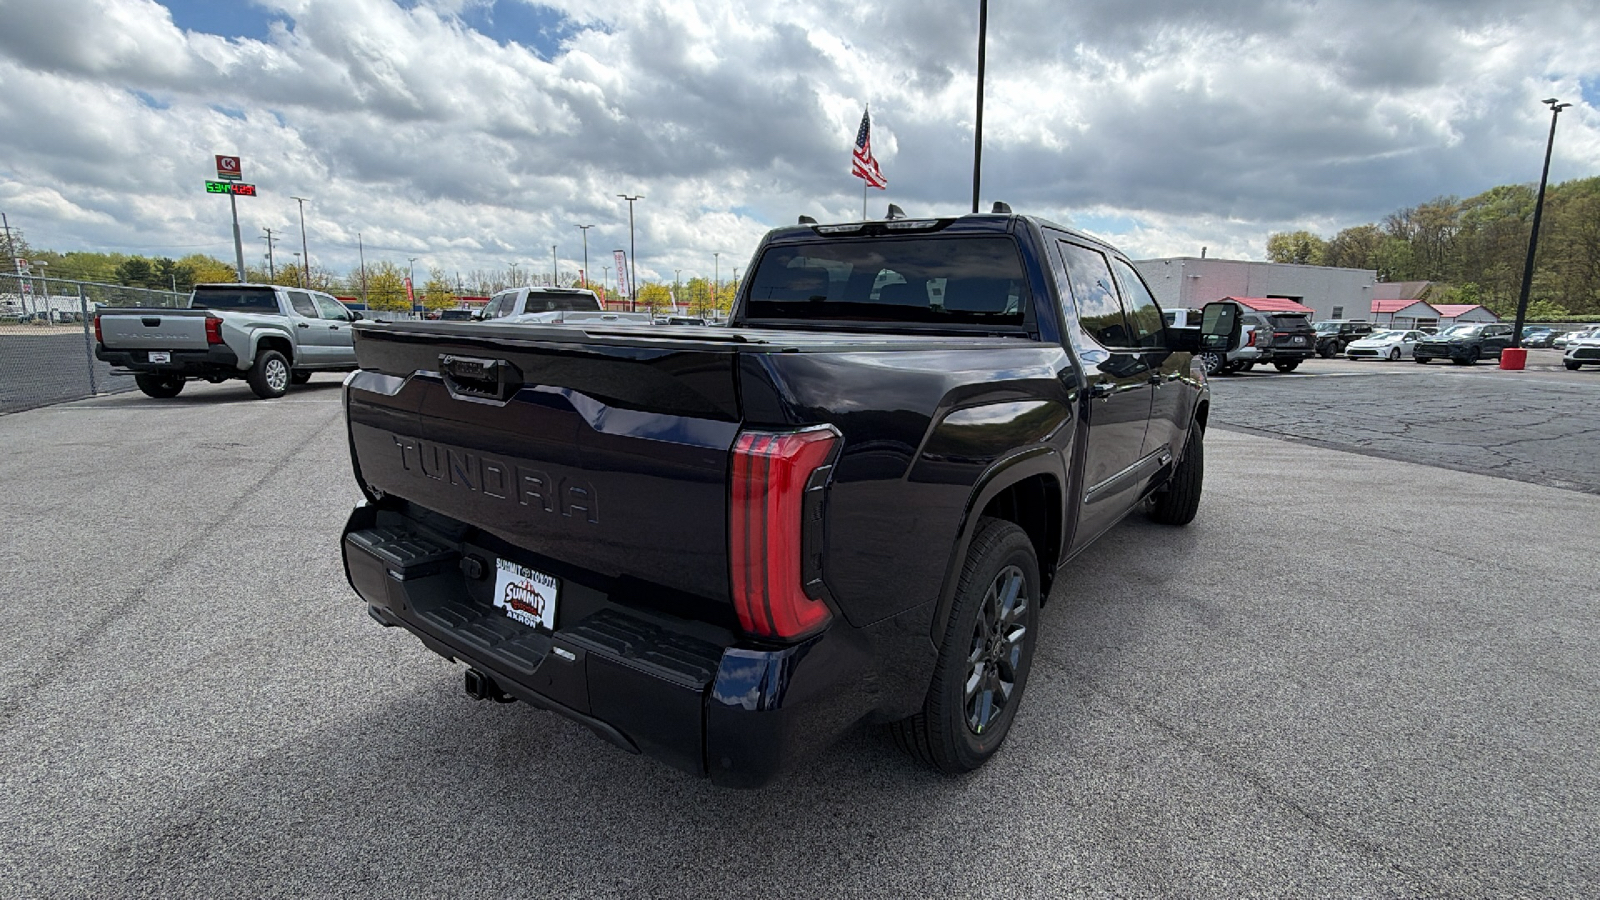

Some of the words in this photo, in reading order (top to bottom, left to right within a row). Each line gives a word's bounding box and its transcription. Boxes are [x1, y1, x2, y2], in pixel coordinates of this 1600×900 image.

[618, 261, 626, 294] TOYOTA
[393, 435, 599, 524] TUNDRA
[496, 557, 522, 576] SUMMIT
[531, 569, 557, 589] TOYOTA
[506, 584, 543, 615] SUMMIT
[506, 609, 536, 629] AKRON
